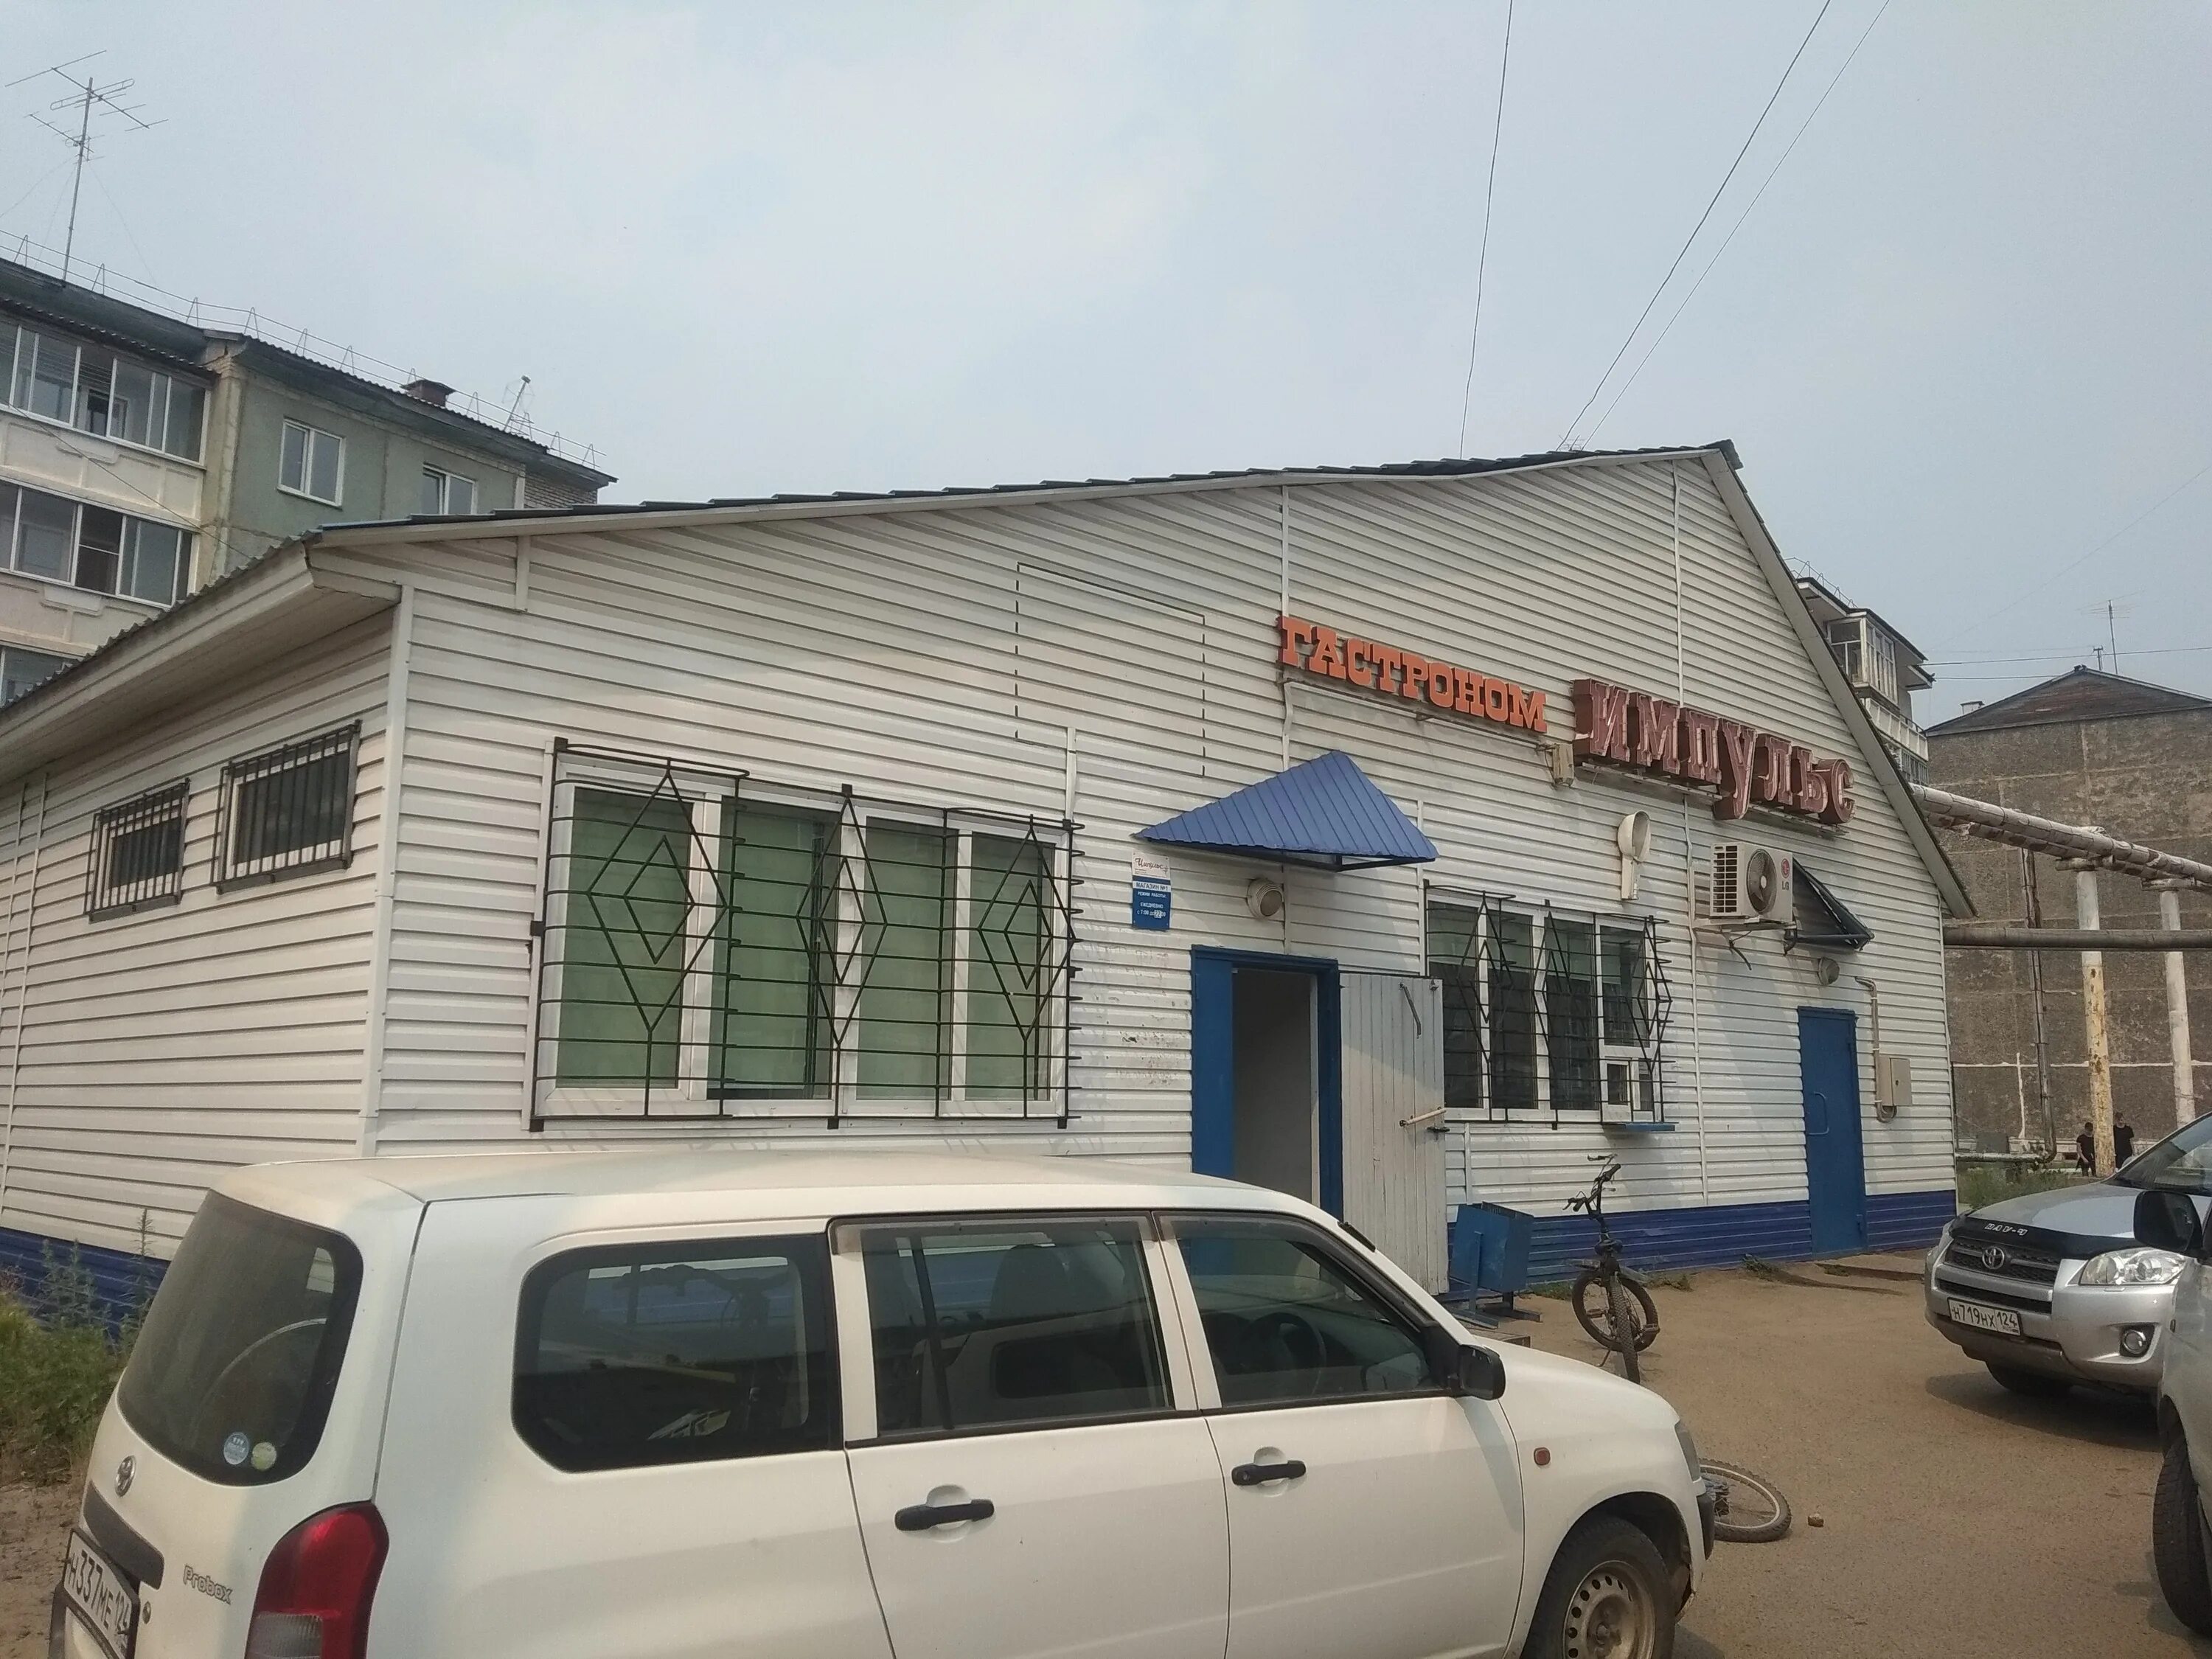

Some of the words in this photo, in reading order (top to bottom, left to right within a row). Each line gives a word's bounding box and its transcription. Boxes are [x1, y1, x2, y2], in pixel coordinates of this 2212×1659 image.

[1276, 616, 1548, 733] ГАСТРОНОМ
[1575, 678, 1857, 821] ИМПУЛЬС
[1136, 882, 1159, 890] МАГАЗИН
[1781, 881, 1790, 891] LG
[1997, 1311, 2017, 1328] 124
[184, 1565, 234, 1605] Probox
